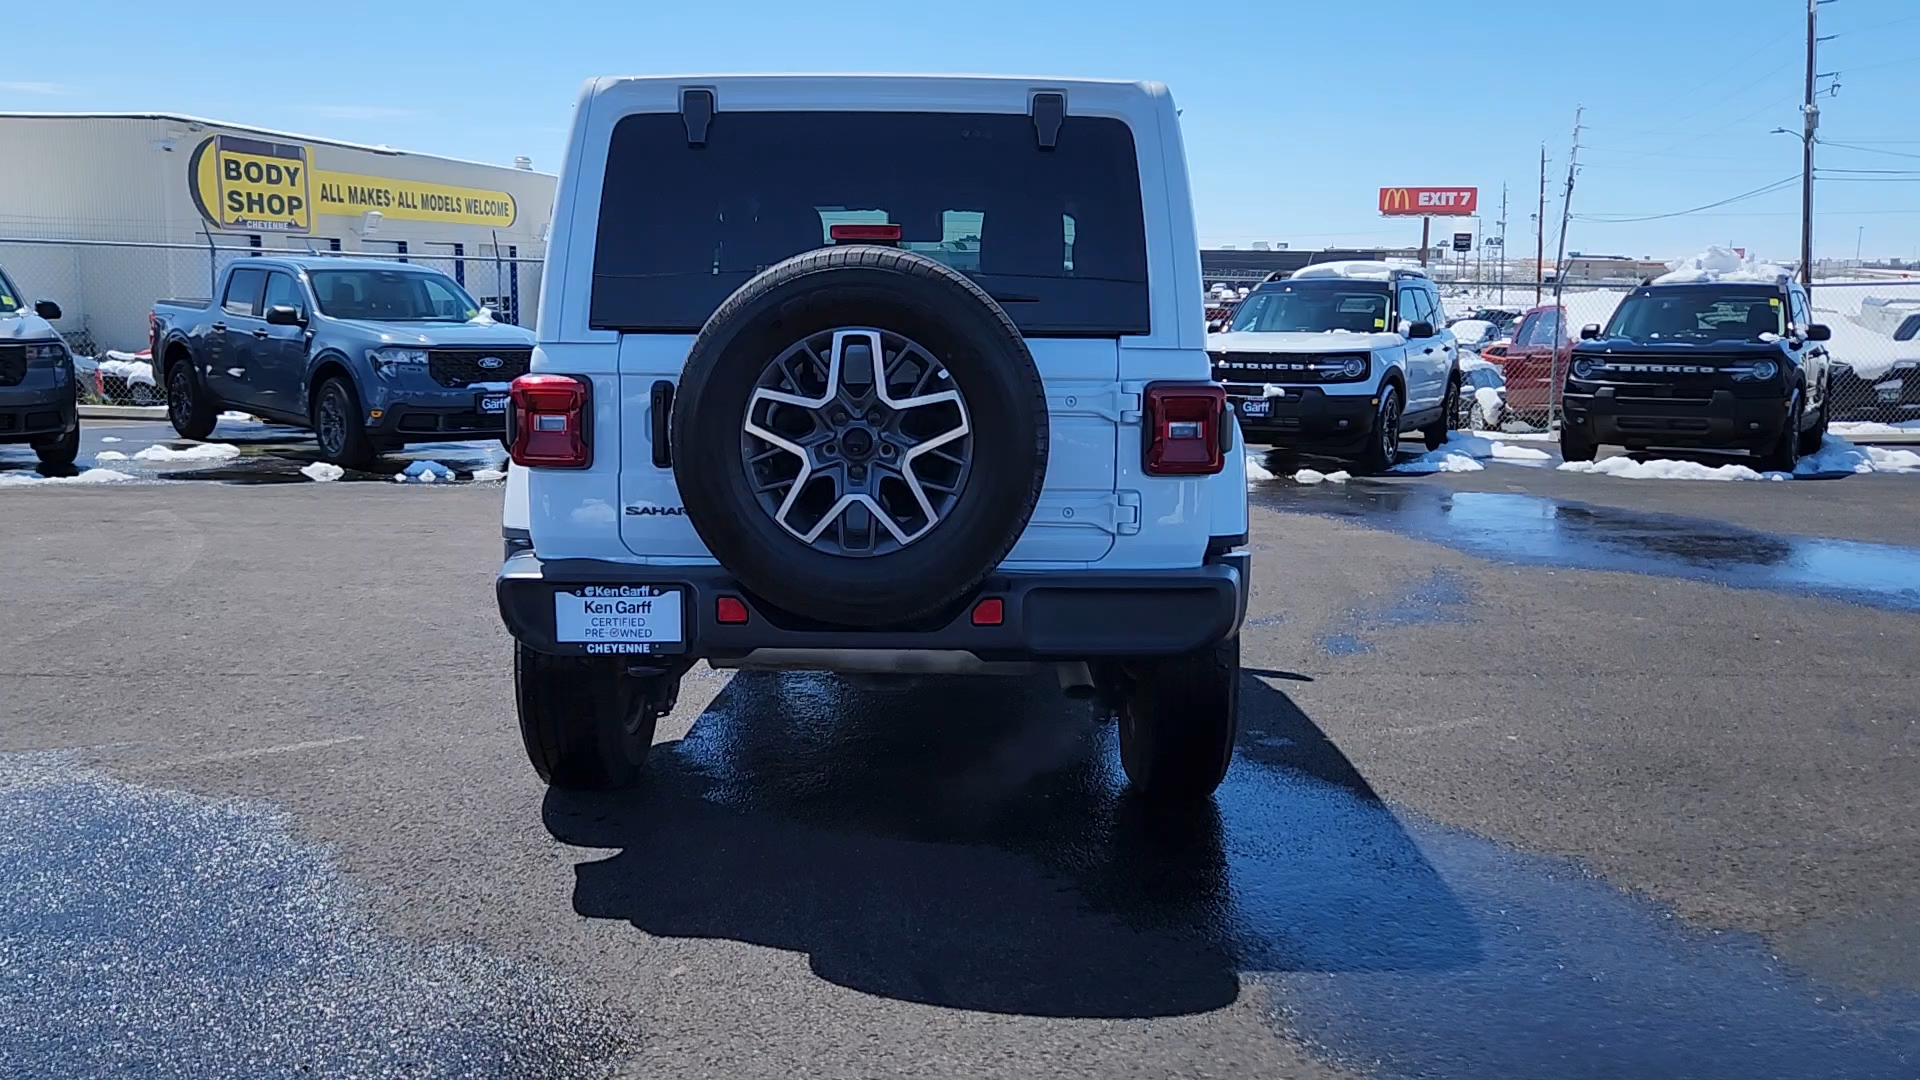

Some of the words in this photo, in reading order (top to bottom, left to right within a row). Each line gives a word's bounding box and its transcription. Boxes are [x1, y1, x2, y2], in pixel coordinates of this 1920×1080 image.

[223, 158, 301, 187] BODY
[227, 189, 303, 216] SHOP
[320, 182, 345, 203] ALL
[347, 185, 391, 207] MAKES
[397, 190, 418, 209] ALL
[420, 193, 462, 213] MODELS
[464, 197, 510, 217] WELCOME
[1418, 191, 1458, 206] EXIT
[1459, 191, 1472, 206] 7
[246, 220, 289, 230] CHEYENNE
[1618, 364, 1714, 372] BRONCO
[1242, 401, 1270, 412] Garff
[625, 506, 688, 516] SAHAR
[595, 586, 619, 597] Ken
[620, 585, 650, 597] Garff
[584, 600, 613, 615] Ken
[615, 600, 652, 615] Garff
[591, 617, 646, 627] CERTIFIED
[586, 643, 651, 654] CHEYENNE
